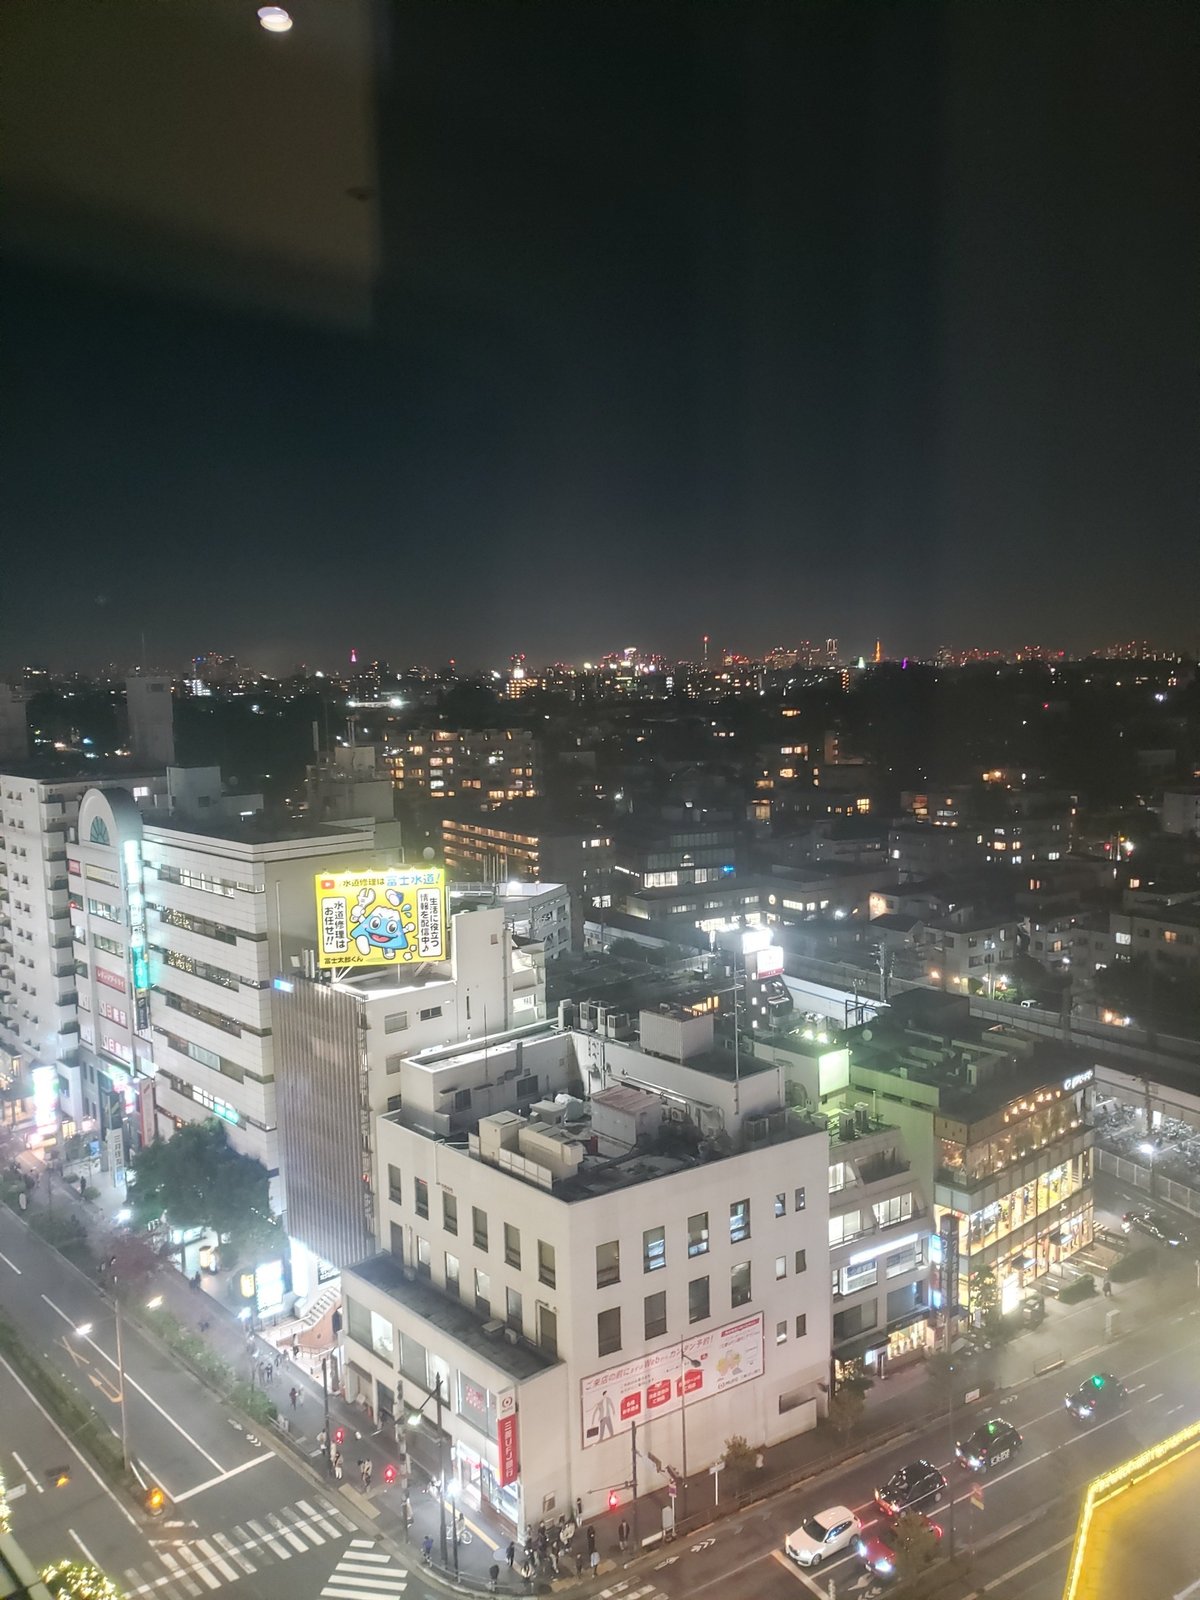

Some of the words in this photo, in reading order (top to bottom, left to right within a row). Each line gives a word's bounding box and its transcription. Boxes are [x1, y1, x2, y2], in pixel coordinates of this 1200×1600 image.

[334, 900, 345, 949] 水道修理は
[430, 898, 439, 947] 生活に役立つ
